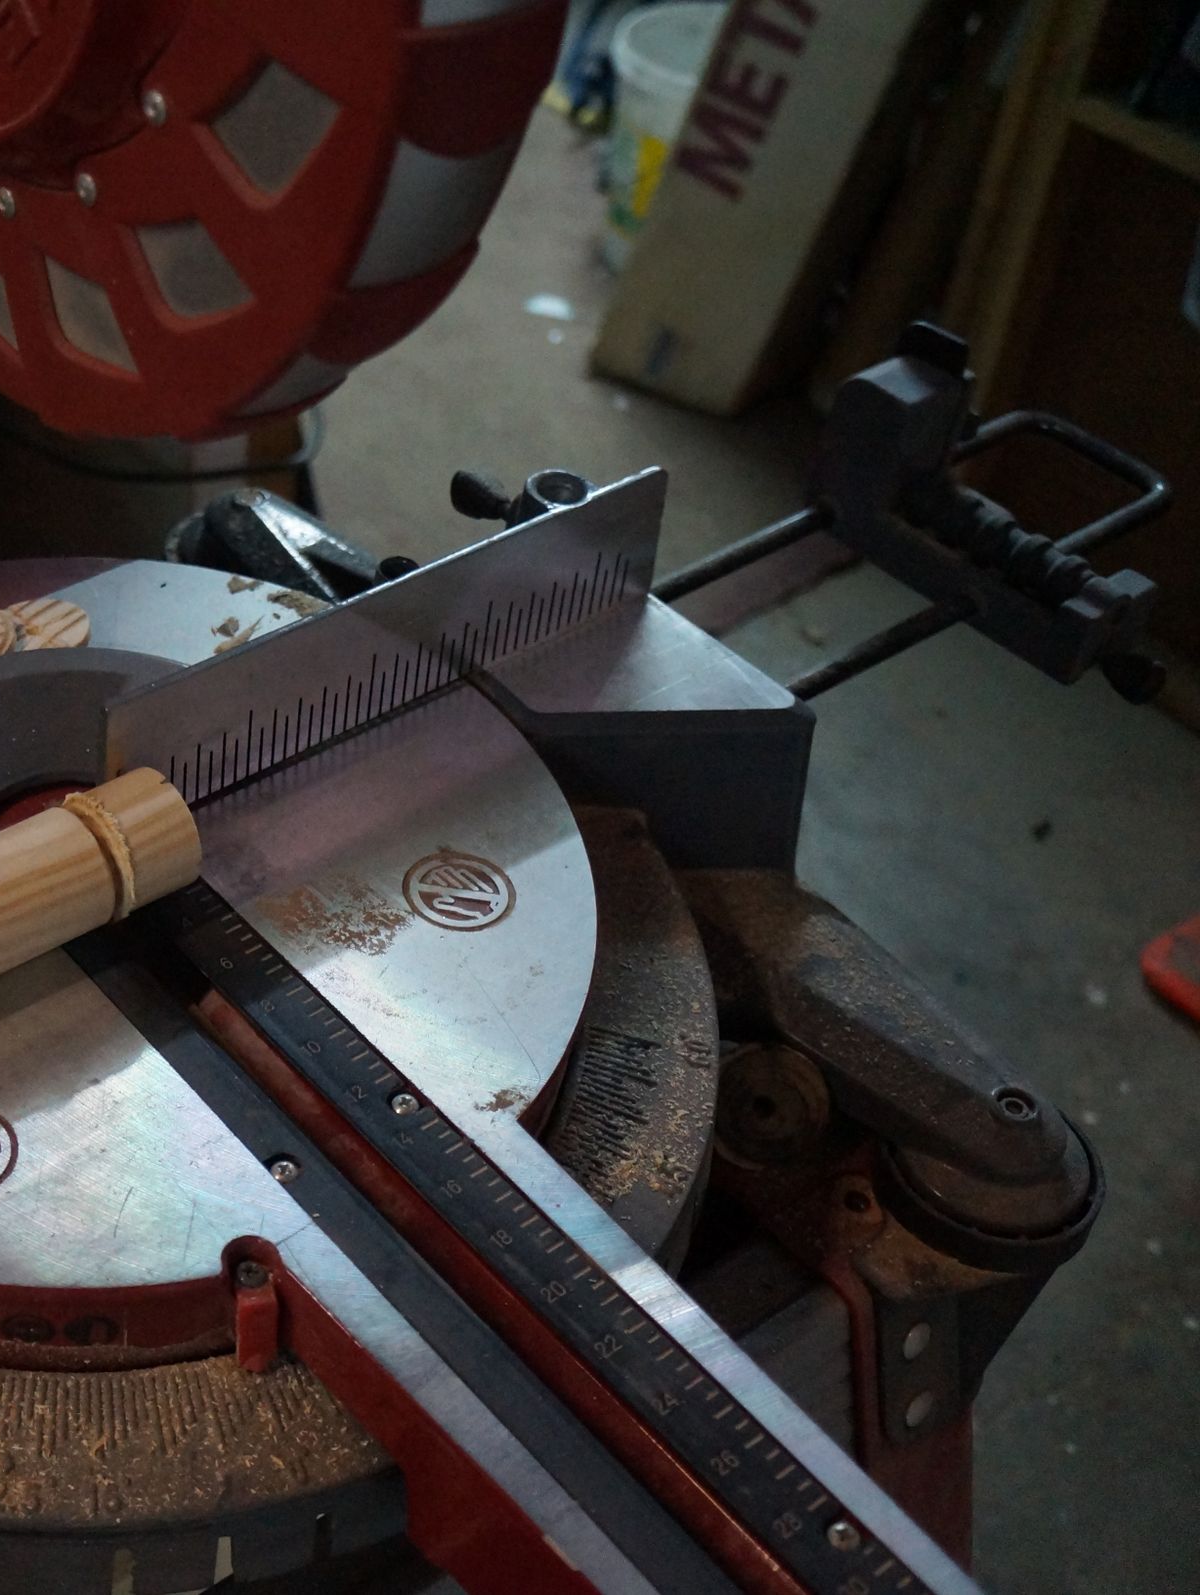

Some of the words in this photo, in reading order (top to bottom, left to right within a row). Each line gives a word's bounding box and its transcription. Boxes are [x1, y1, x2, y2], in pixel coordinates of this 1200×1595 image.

[674, 0, 814, 201] MET
[219, 956, 234, 969] 6
[440, 1179, 462, 1198] 16
[490, 1229, 513, 1249] 18
[540, 1280, 567, 1304] 20
[594, 1333, 623, 1360] 22
[652, 1391, 680, 1416] 24
[710, 1449, 740, 1476] 26
[773, 1512, 802, 1539] 28
